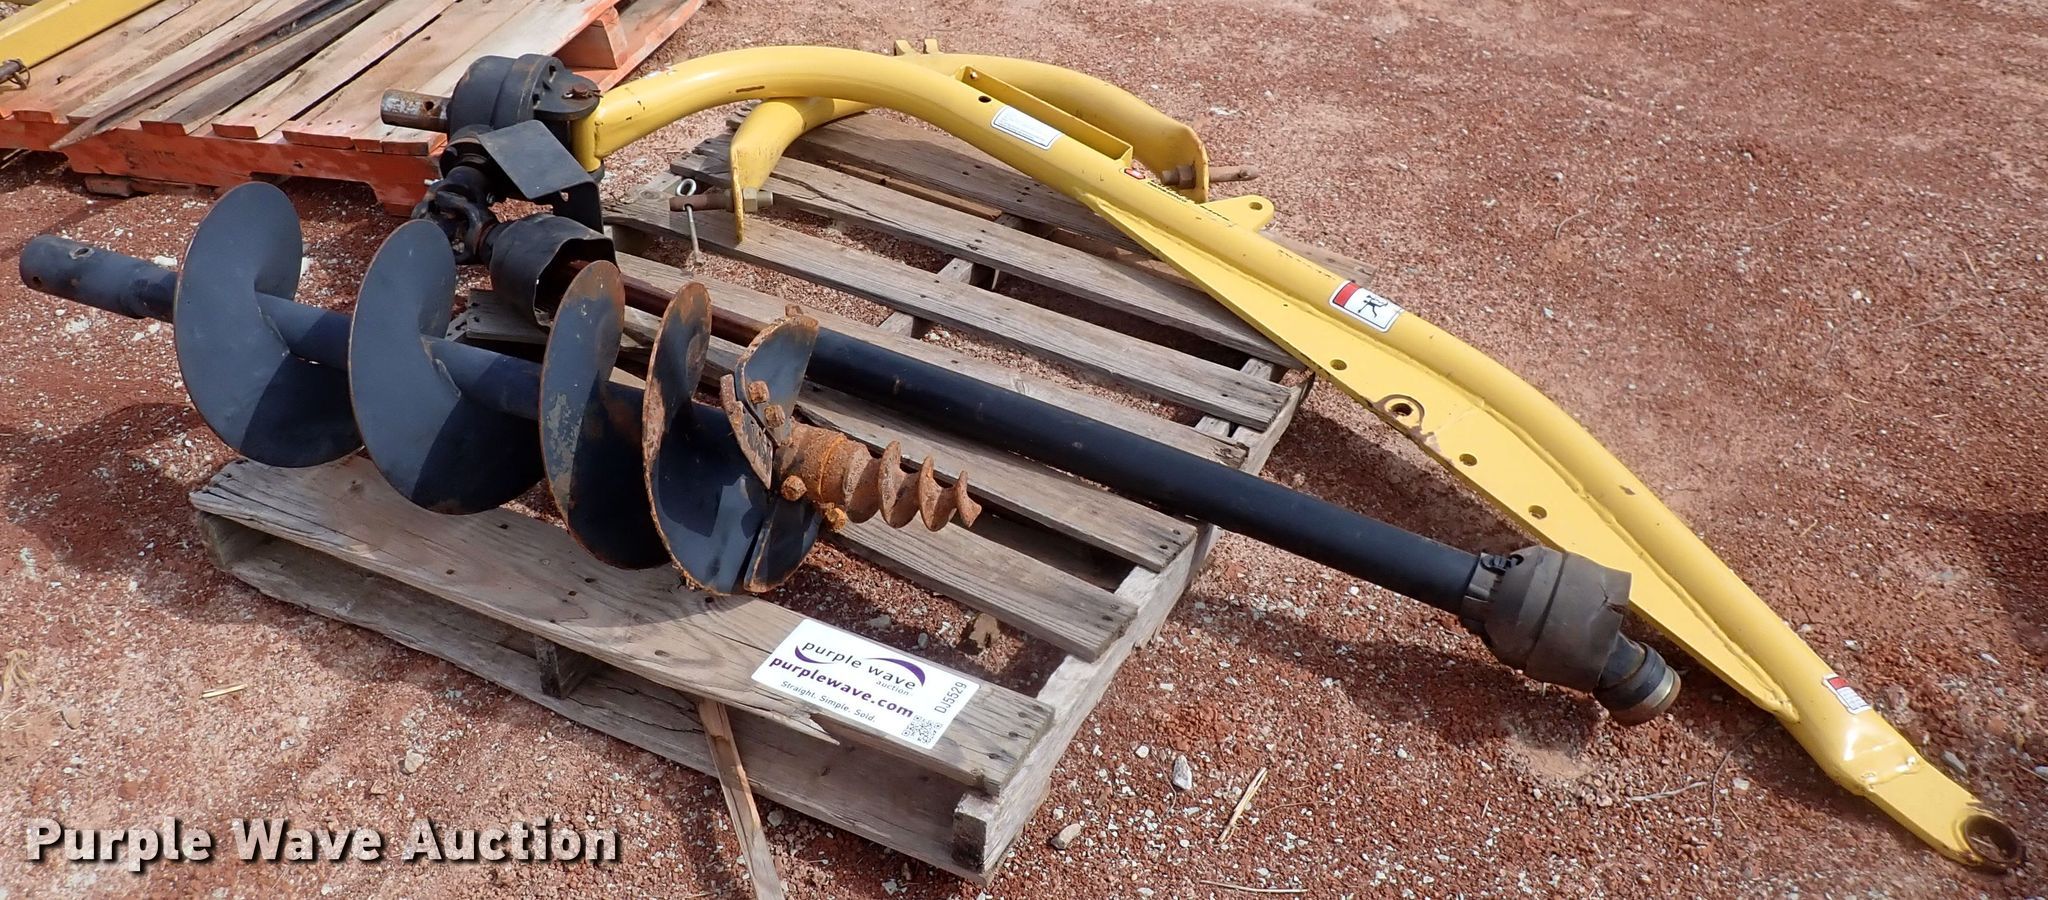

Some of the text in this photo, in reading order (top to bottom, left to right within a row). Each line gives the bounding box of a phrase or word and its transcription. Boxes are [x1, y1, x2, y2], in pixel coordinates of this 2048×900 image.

[769, 657, 914, 718] purplewave.com
[802, 642, 916, 690] purple wave
[780, 680, 876, 723] Straight. Simple. Sold.
[934, 682, 968, 714] DJ5529
